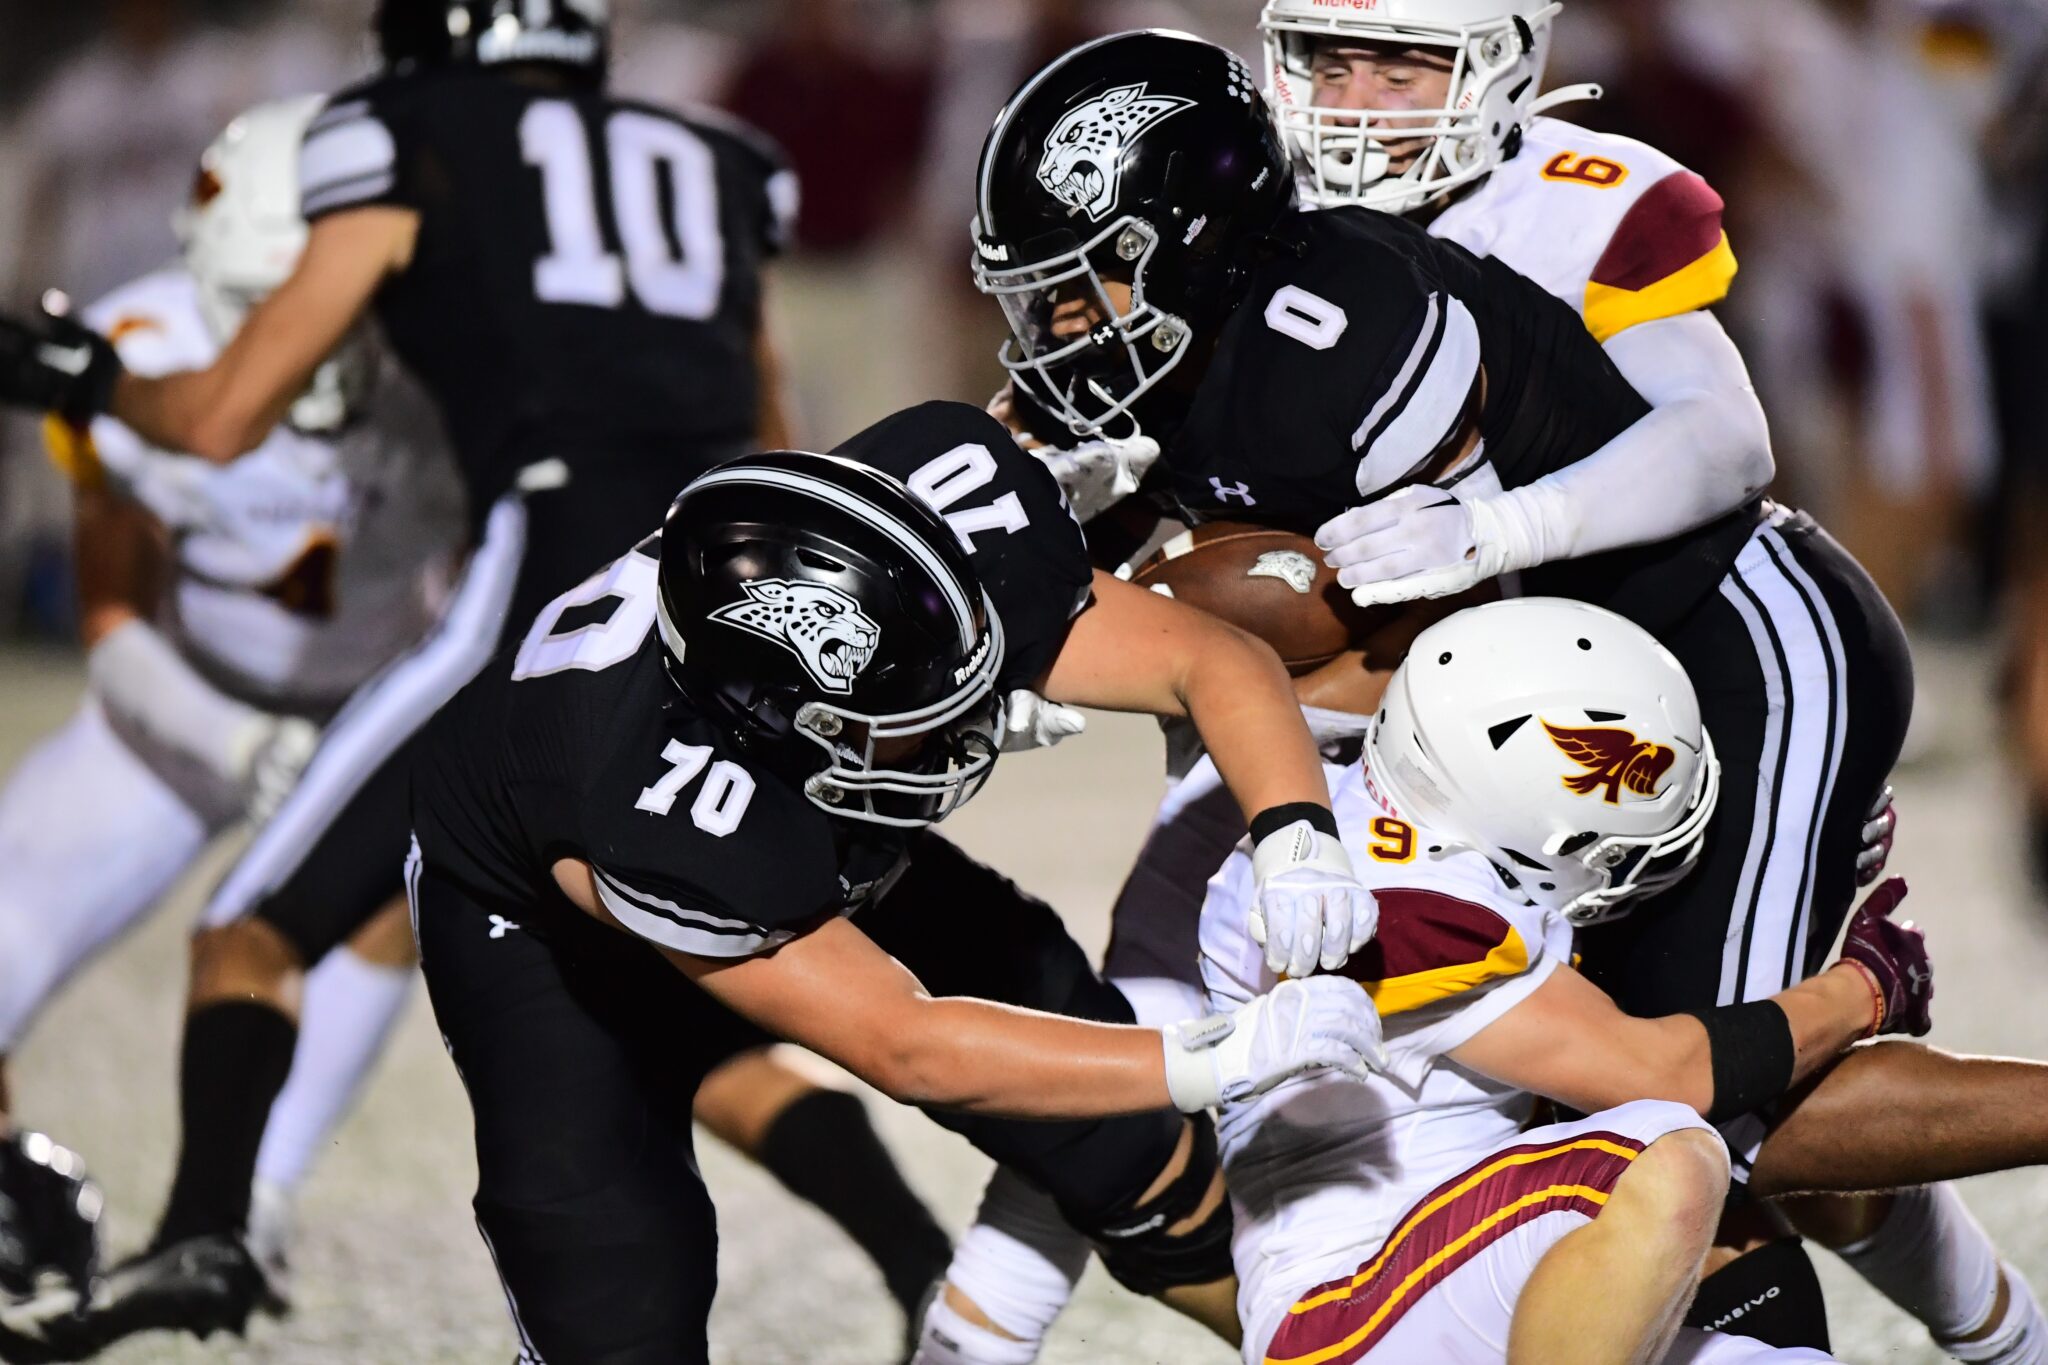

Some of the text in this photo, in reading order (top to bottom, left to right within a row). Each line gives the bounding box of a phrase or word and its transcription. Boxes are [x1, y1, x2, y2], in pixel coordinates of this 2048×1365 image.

[519, 98, 726, 321] 10
[1539, 150, 1630, 189] 6
[1263, 284, 1348, 351] 0
[906, 442, 1031, 556] 70
[634, 738, 757, 838] 70
[1367, 816, 1419, 864] 9
